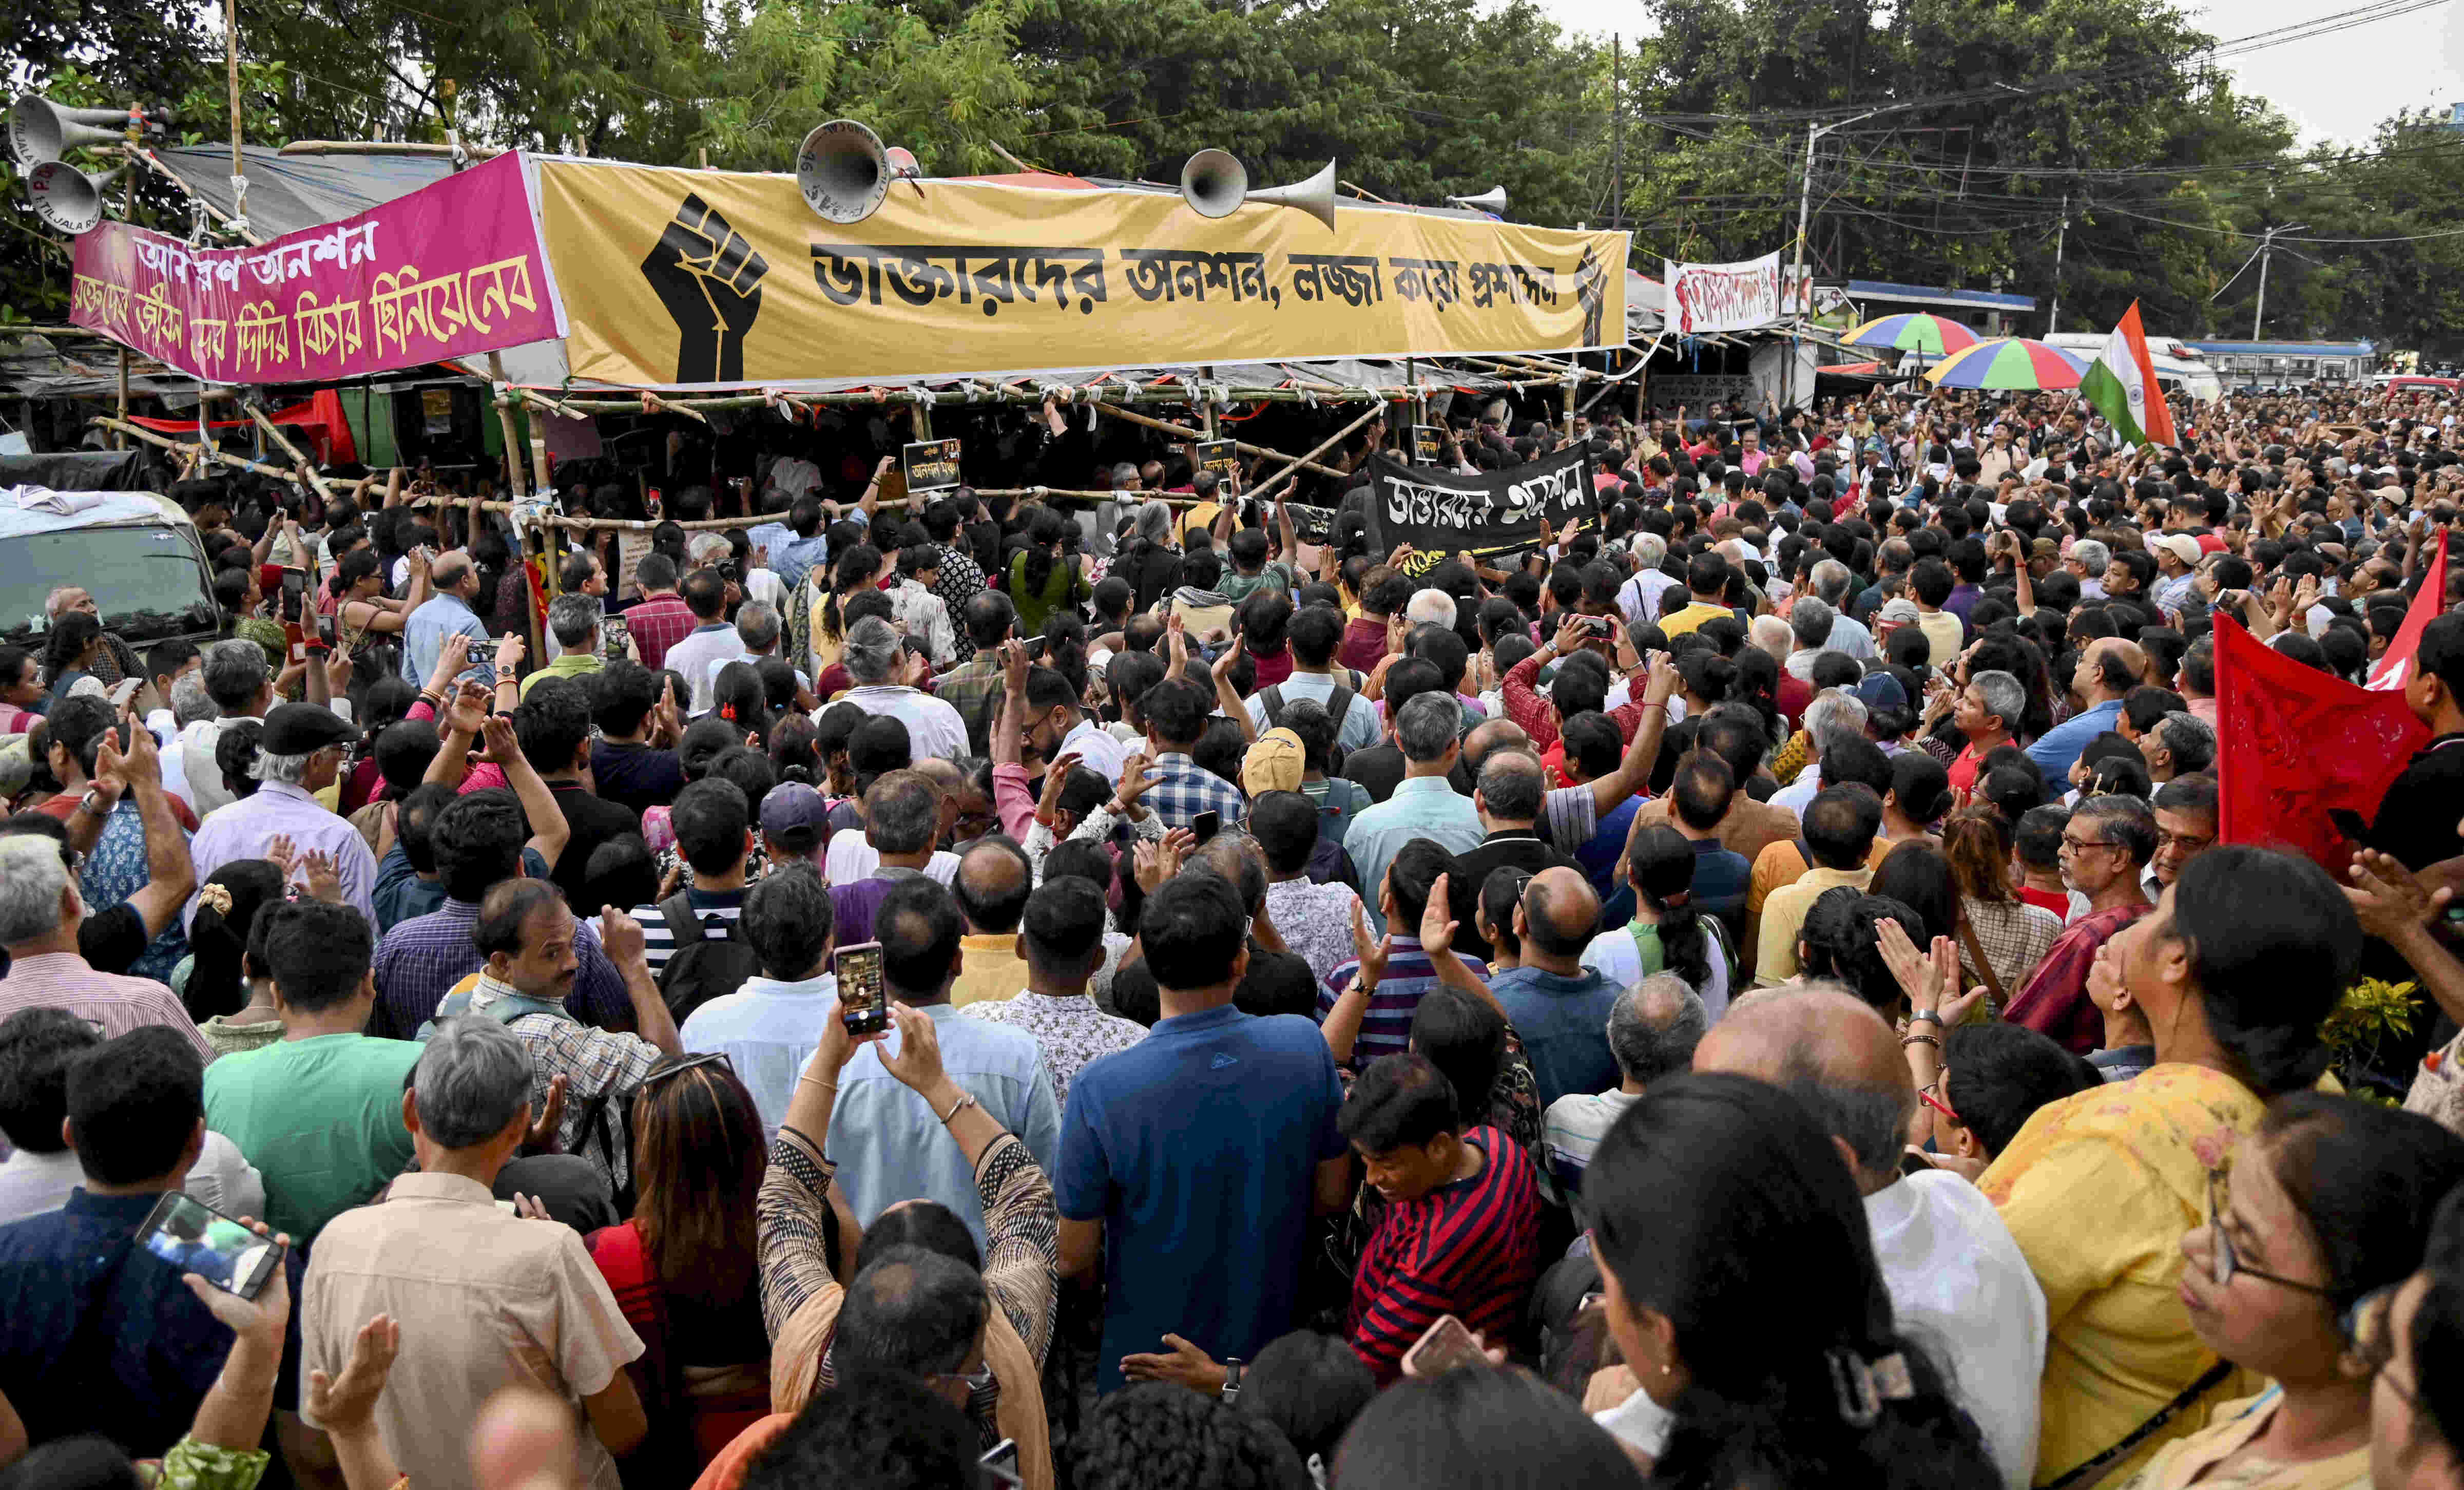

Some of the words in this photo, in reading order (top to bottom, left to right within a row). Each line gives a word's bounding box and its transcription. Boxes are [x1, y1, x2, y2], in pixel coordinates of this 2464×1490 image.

[40, 200, 83, 230] TILJALA
[245, 221, 379, 284] অনশন
[811, 243, 1108, 317] ডাক্তারদের
[1120, 249, 1280, 310] অনশন,
[1287, 254, 1384, 307] লজ্জা
[1389, 257, 1460, 312] করো
[1469, 262, 1557, 308] প্রশাসন
[134, 282, 183, 350] জীবন
[235, 300, 290, 373] দিদির
[294, 290, 362, 369] বিচার
[911, 463, 942, 480] অনশন
